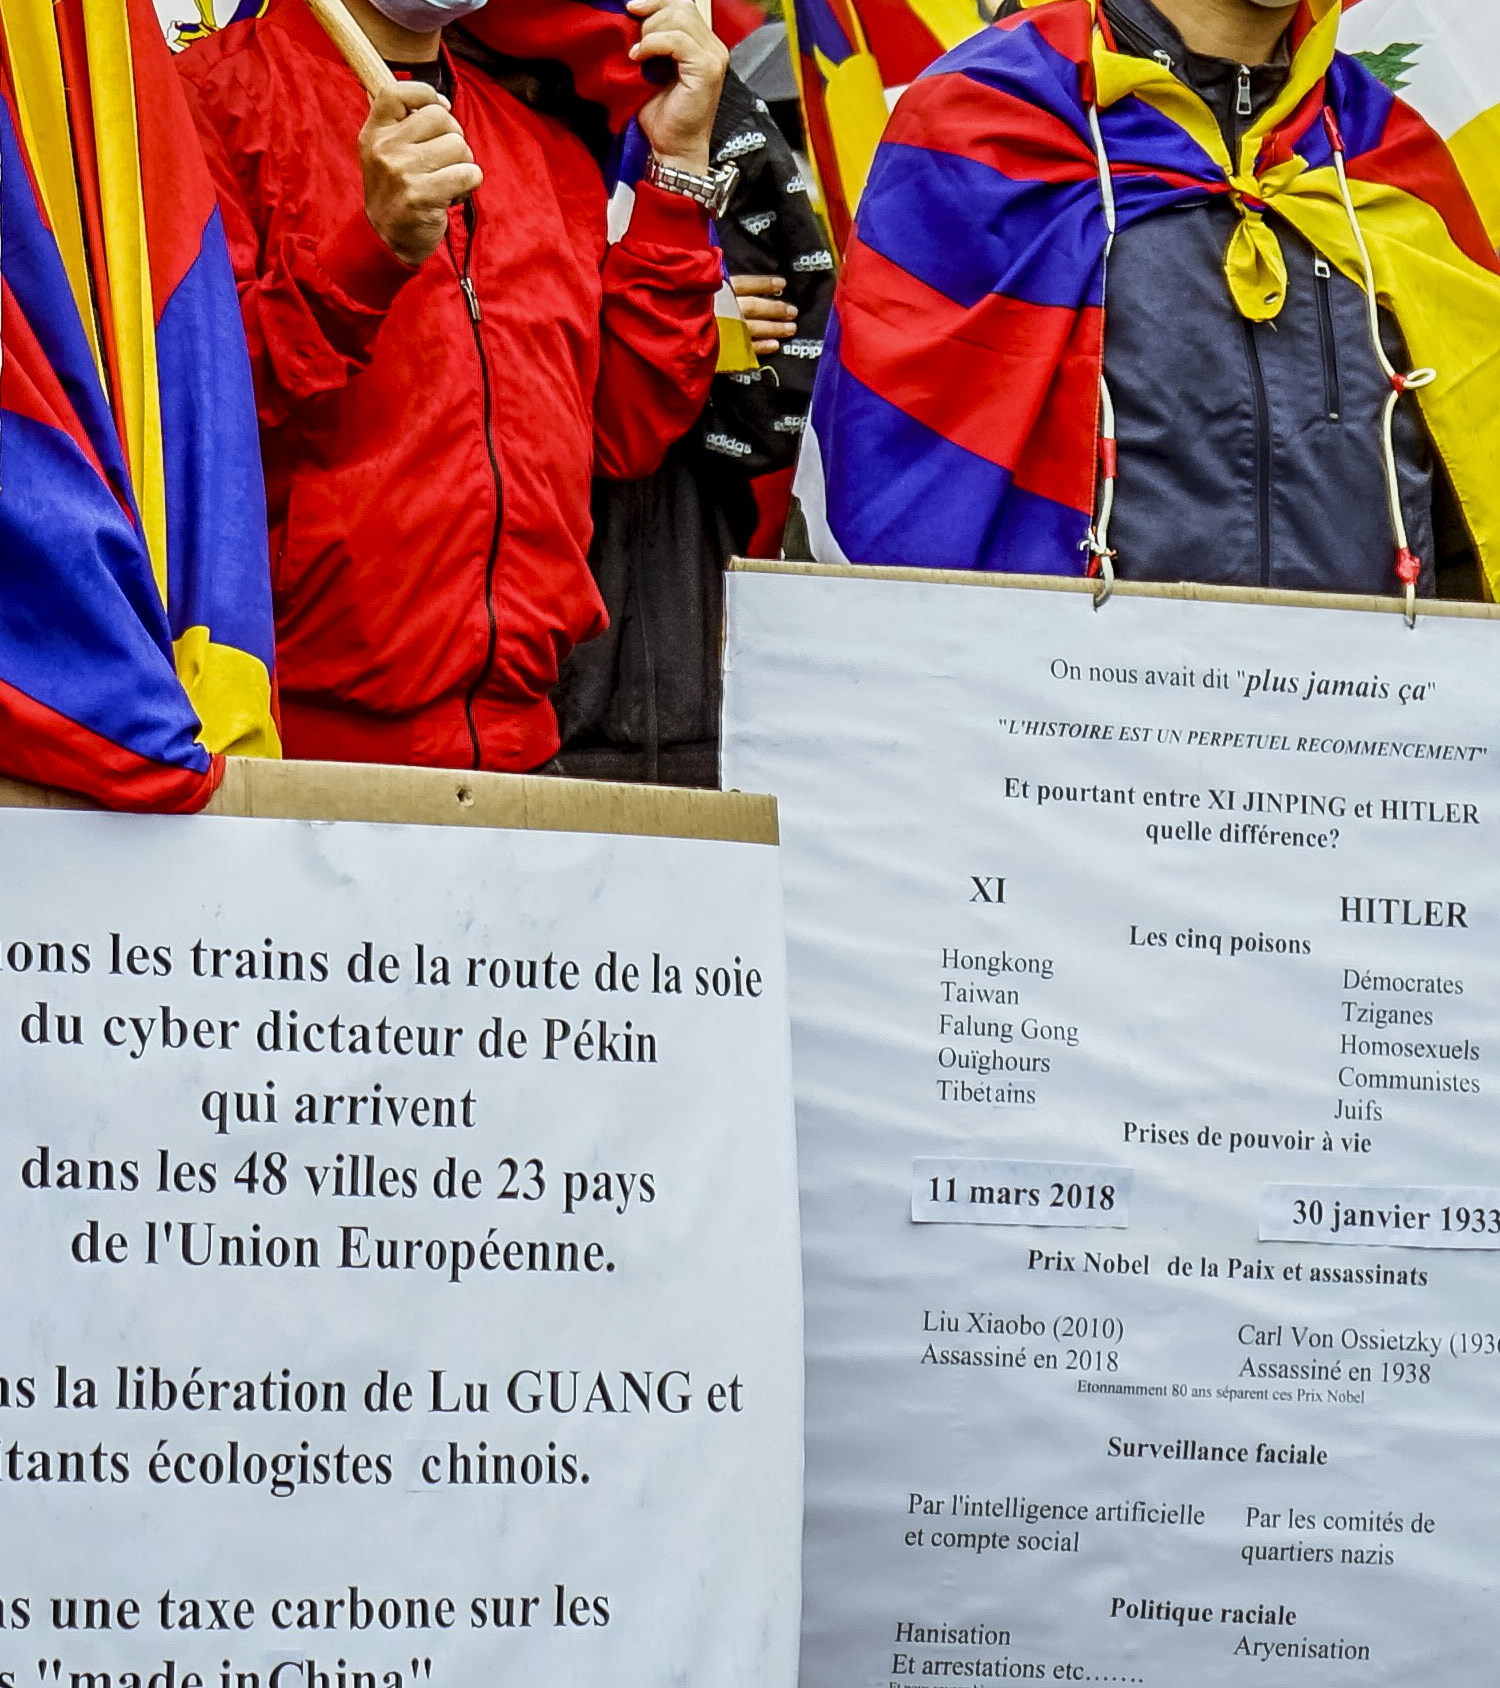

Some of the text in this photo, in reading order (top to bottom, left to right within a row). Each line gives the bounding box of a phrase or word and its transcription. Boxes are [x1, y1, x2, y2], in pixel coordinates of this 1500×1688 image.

[706, 432, 752, 455] adidas
[1051, 659, 1435, 705] On nous avait dit "plus jamais ça"
[1005, 777, 1480, 824] Et pourtant entre XI JINPING et HITLER
[1146, 821, 1339, 848] quelle différence?
[969, 876, 1006, 903] XI
[1340, 896, 1468, 928] HITLER
[1129, 925, 1311, 956] Les cinq poisons
[109, 932, 172, 976] les
[190, 938, 328, 982] trains
[347, 942, 400, 983] de
[415, 943, 451, 986] la
[466, 952, 579, 990] route
[595, 950, 639, 992] de
[652, 953, 682, 994] la
[696, 956, 762, 997] soie
[942, 948, 1053, 979] Hongkong
[941, 981, 1018, 1005] Taiwan
[1343, 969, 1463, 994] Démocrates
[939, 1014, 1079, 1047] Falung Gong
[1342, 1001, 1433, 1029] Tziganes
[21, 1001, 657, 1063] du cyber dictateur de Pékin
[1341, 1034, 1479, 1060] Homosexuels
[939, 1047, 1050, 1075] Ouïghours
[1339, 1066, 1480, 1093] Communistes
[202, 1080, 476, 1135] qui arrivent
[1334, 1099, 1382, 1121] Juifs
[1123, 1122, 1371, 1153] Prises de pouvoir à vie
[22, 1146, 655, 1214] dans les 48 villes de 23 pays
[929, 1177, 1115, 1210] 11 mars 2018
[1293, 1200, 1323, 1225] 30
[1330, 1201, 1430, 1233] janvier
[72, 1220, 615, 1283] de l'Union Européenne.
[1027, 1250, 1427, 1286] Prix Nobel de la Paix et assassinats
[923, 1310, 1123, 1344] Liu Xiaobo (2010)
[55, 1365, 98, 1409] la
[116, 1366, 347, 1412] libération
[364, 1370, 412, 1412] de
[428, 1370, 489, 1412] Lu
[507, 1370, 692, 1413] GUANG
[707, 1374, 743, 1412] et
[1108, 1436, 1327, 1465] Surveillance faciale
[149, 1439, 392, 1497] écologistes
[422, 1441, 589, 1484] chinois.
[50, 1598, 140, 1630] une
[158, 1589, 254, 1630] taxe
[272, 1586, 455, 1630] carbone
[471, 1597, 539, 1628] sur
[553, 1585, 609, 1626] les
